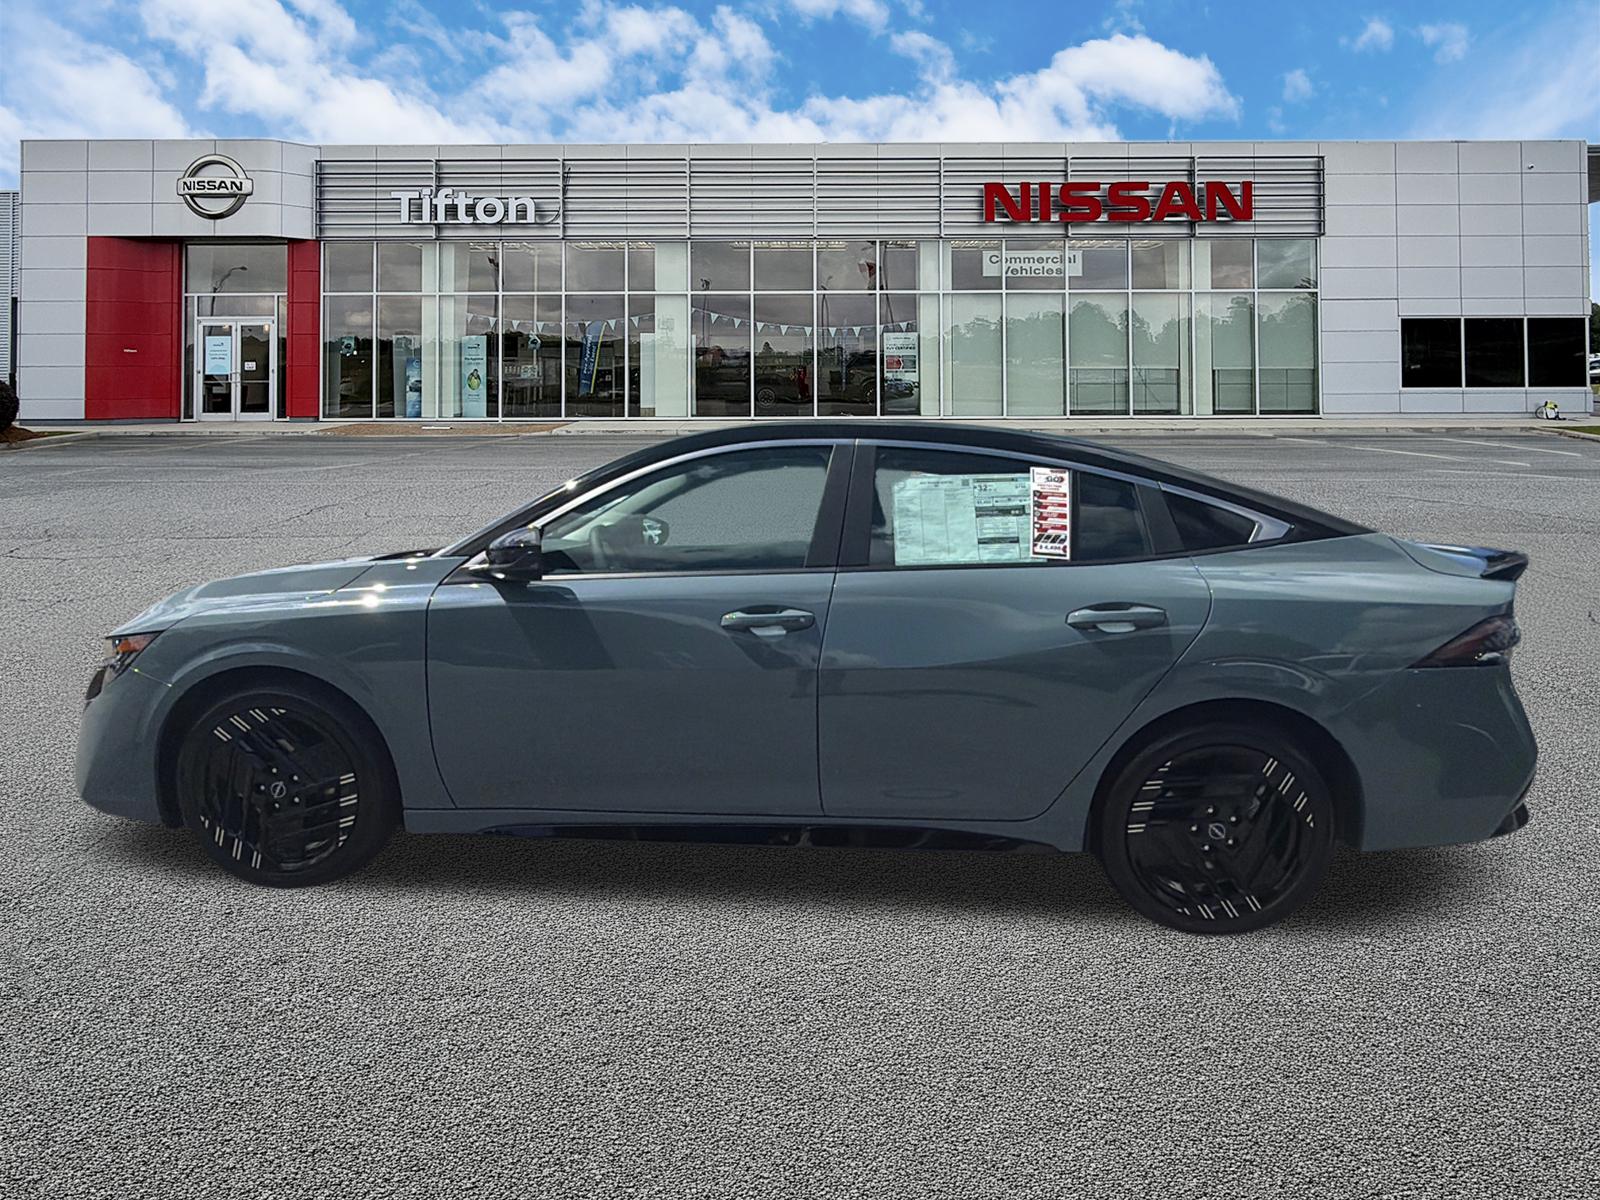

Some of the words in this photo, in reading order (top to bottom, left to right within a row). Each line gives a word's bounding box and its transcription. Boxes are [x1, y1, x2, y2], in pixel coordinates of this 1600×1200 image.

[182, 180, 243, 191] NISSAN
[983, 181, 1253, 222] NISSAN
[390, 187, 536, 224] Tifton
